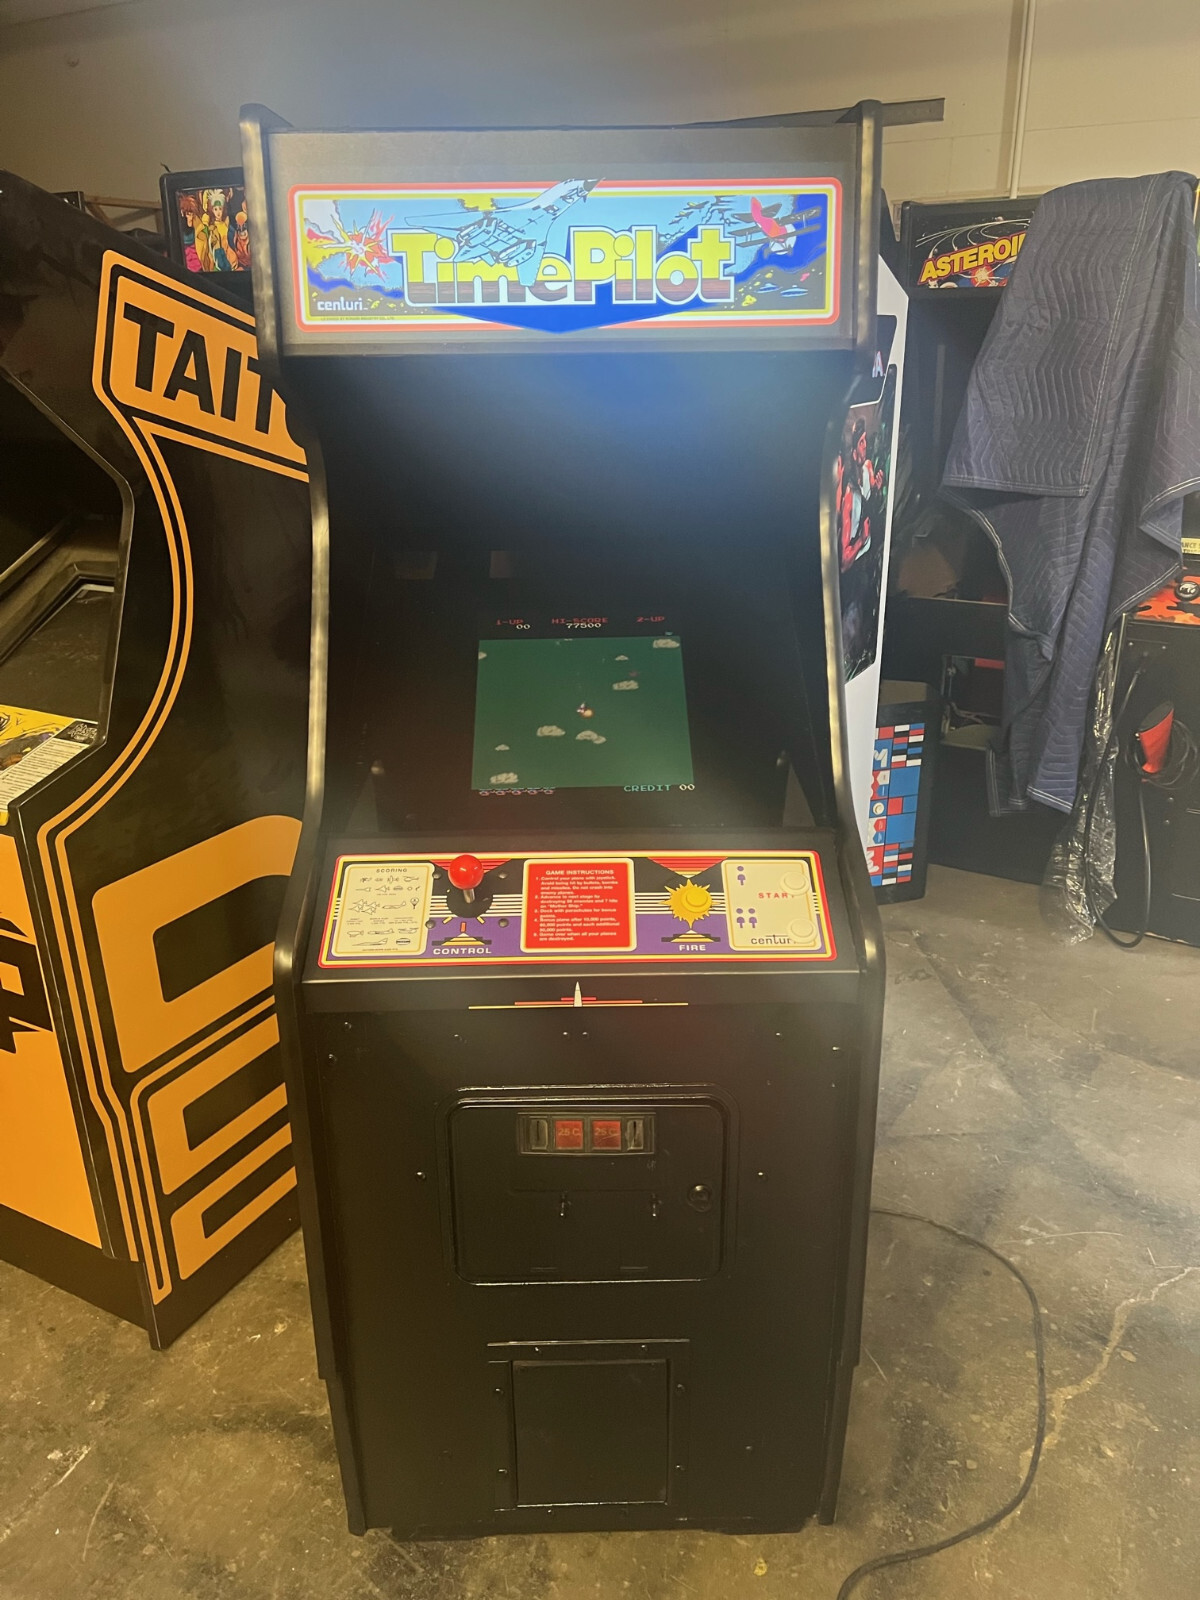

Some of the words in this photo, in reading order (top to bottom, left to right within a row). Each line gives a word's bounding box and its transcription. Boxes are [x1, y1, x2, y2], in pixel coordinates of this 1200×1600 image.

[919, 232, 1026, 284] ASTEROI
[123, 301, 277, 435] TAIT
[678, 783, 696, 791] 00
[750, 934, 796, 944] centur
